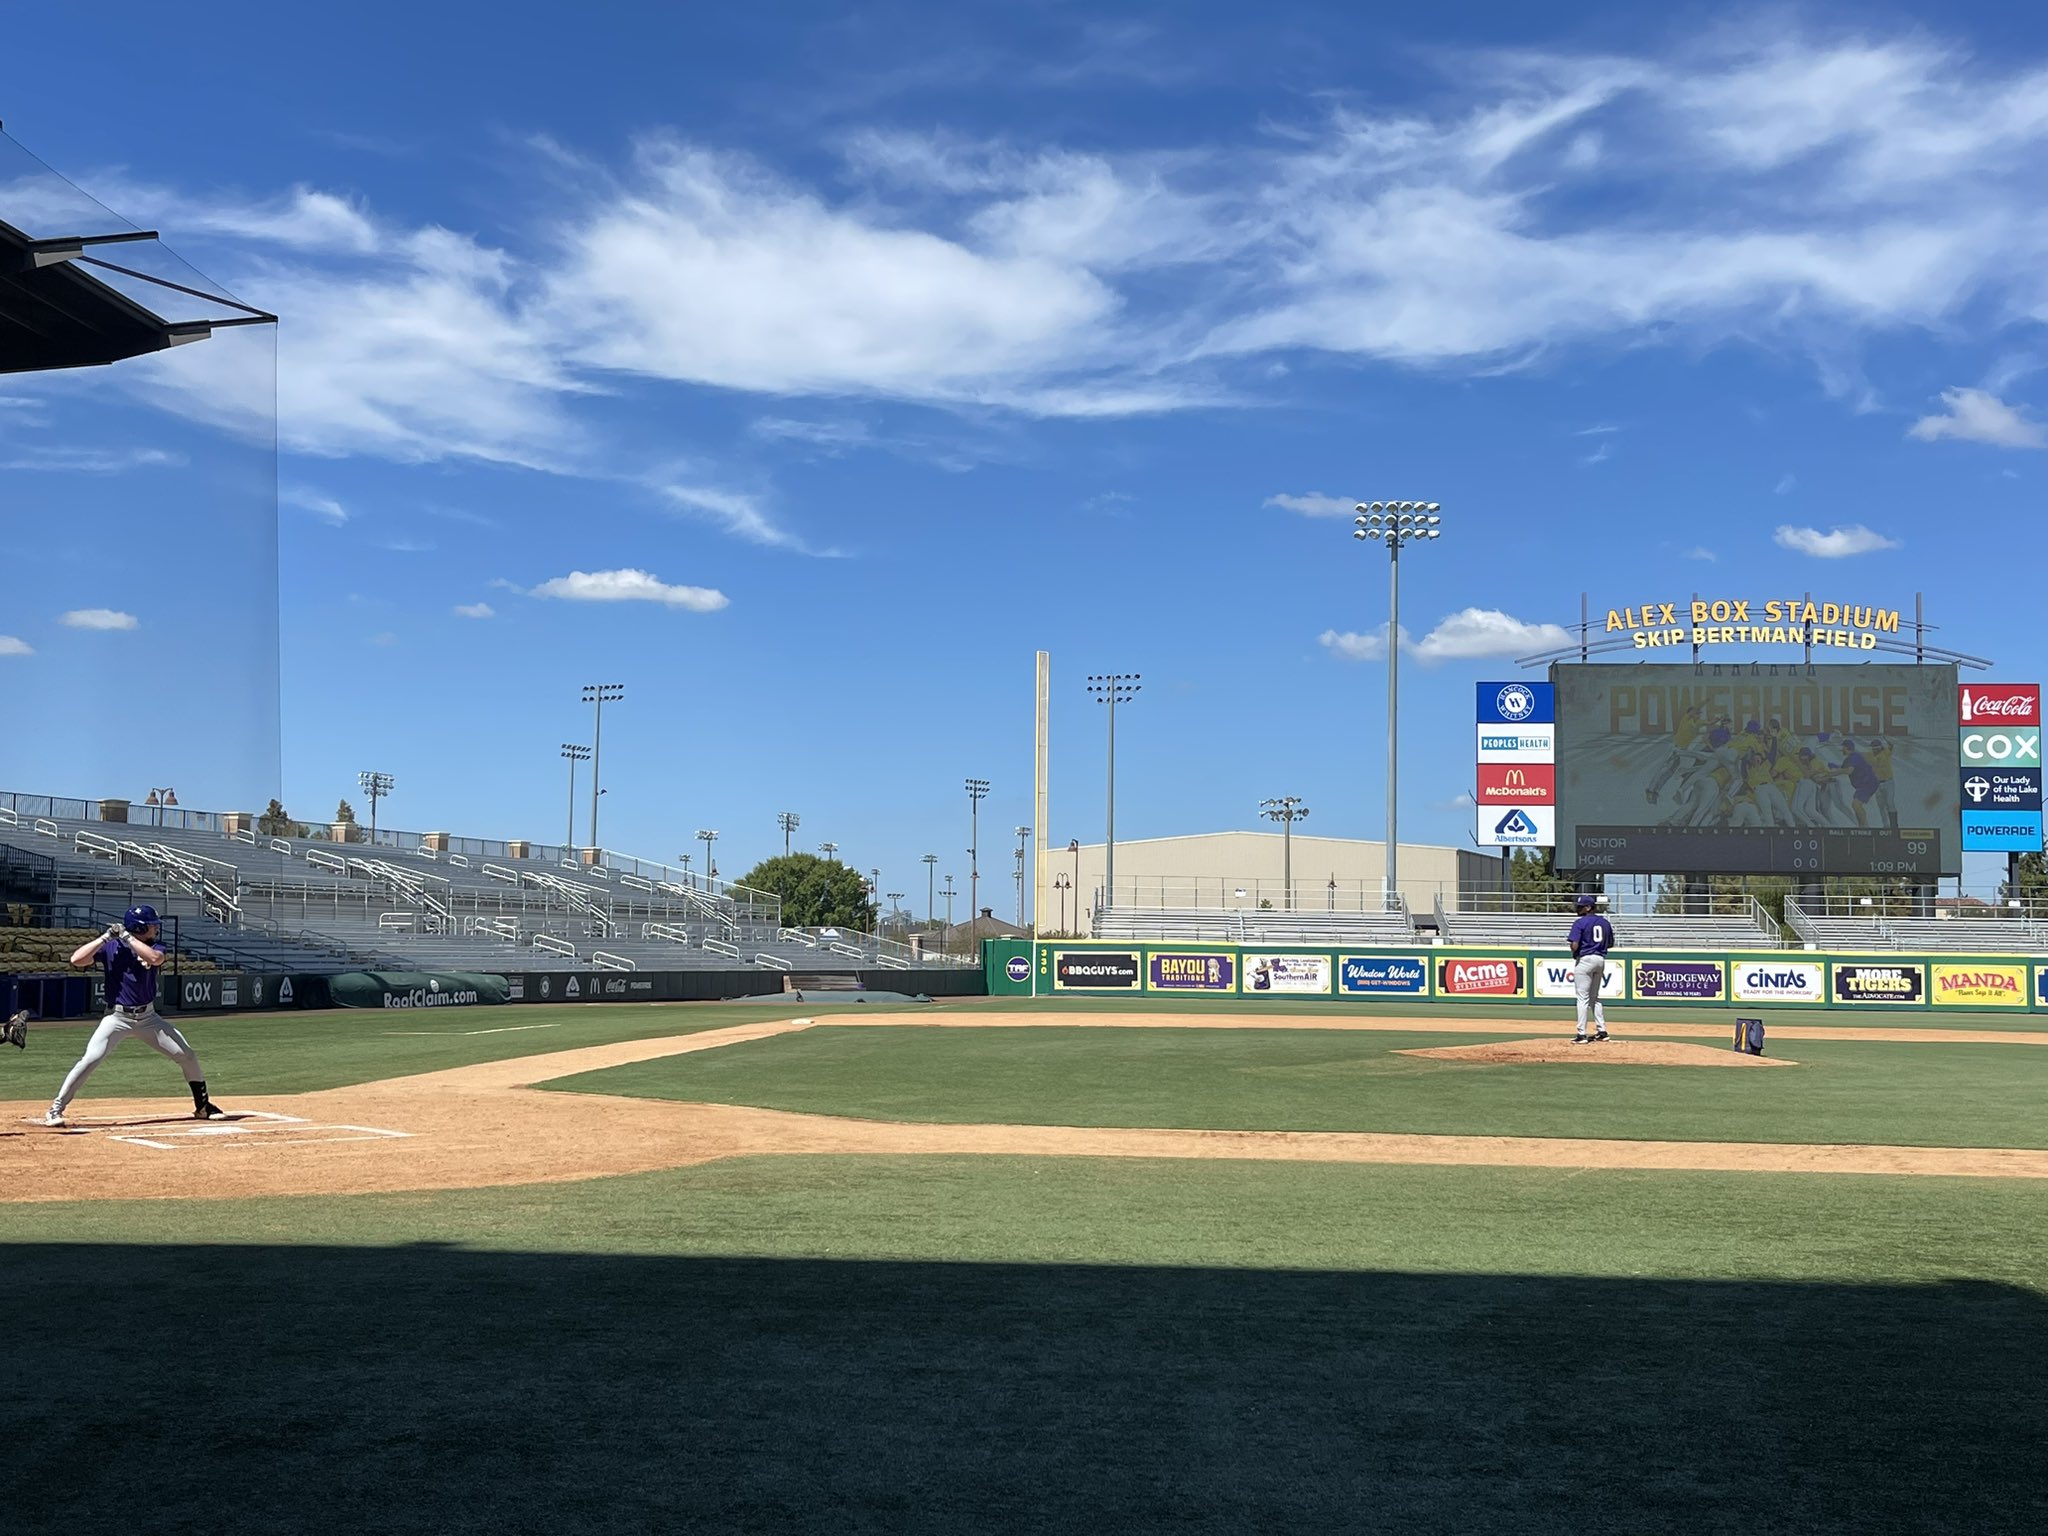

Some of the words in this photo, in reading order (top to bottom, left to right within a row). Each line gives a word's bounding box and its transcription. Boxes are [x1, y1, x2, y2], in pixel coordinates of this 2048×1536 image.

[1605, 602, 1677, 632] ALEX
[1691, 600, 1750, 623] BOX
[1765, 600, 1899, 633] STADIUM
[1633, 628, 1685, 649] SKIP
[1692, 626, 1804, 644] BERTMAN
[1812, 628, 1877, 650] FIELD
[1499, 685, 1531, 701] HANCOCK
[1499, 704, 1532, 719] WHITNEY
[1610, 684, 1910, 737] POWERHOUSE
[1973, 695, 2036, 716] Coca-Cola
[1482, 737, 1517, 748] PEOPLES
[1520, 737, 1549, 748] HEALTH
[1963, 734, 2038, 759] COX
[1993, 776, 2009, 784] Our
[2010, 776, 2031, 787] Lady
[1993, 785, 2003, 793] of
[2004, 785, 2018, 793] the
[2019, 785, 2038, 793] Lake
[1485, 786, 1547, 796] McDonald's
[1993, 794, 2020, 803] Health
[1494, 834, 1537, 843] Albertsons
[1967, 825, 2036, 836] POWERADE
[1578, 838, 1627, 848] VISITOR
[1794, 840, 1802, 850] 0
[1809, 840, 1818, 850] 0
[1907, 842, 1927, 855] 99
[1578, 855, 1614, 865] HOME
[1794, 858, 1802, 868] 0
[1809, 858, 1818, 868] 0
[1870, 862, 1893, 872] 1:09
[1897, 862, 1916, 872] PM
[1592, 925, 1603, 943] 0
[1161, 958, 1206, 974] BAYOU
[1347, 964, 1386, 978] Window
[1387, 965, 1420, 978] World
[1454, 963, 1508, 983] Acme
[1855, 968, 1902, 980] MORE
[1162, 974, 1206, 982] TRADITIONS
[1656, 970, 1720, 982] BRIDGEWAY
[1939, 972, 2018, 992] MANDA
[184, 982, 212, 1002] COX
[1846, 977, 1912, 992] TIGERS
[384, 987, 478, 1008] RoofClaim.com
